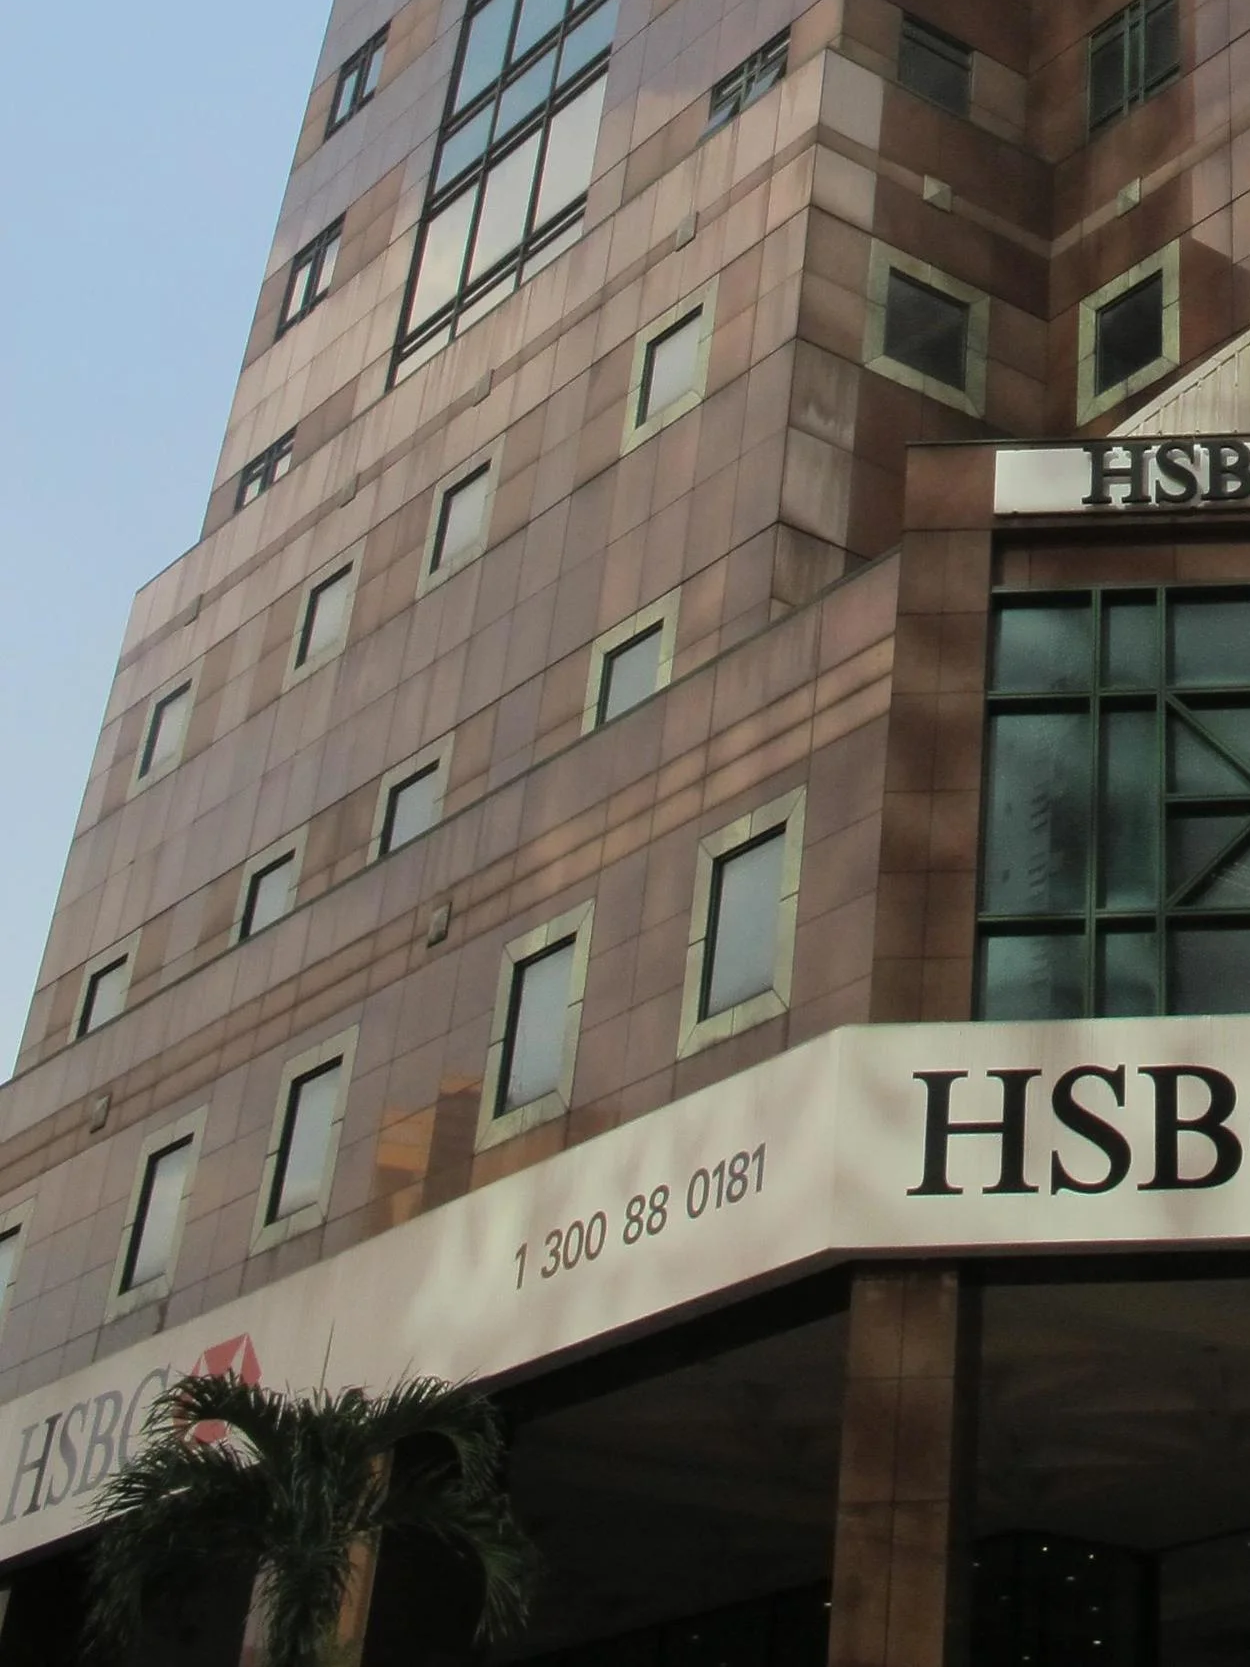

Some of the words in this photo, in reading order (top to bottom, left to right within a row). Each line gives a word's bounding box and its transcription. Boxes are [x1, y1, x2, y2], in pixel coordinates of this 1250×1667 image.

[514, 1242, 528, 1290] 1
[540, 1210, 608, 1279] 300
[622, 1184, 670, 1245] 88
[686, 1142, 767, 1220] 0181
